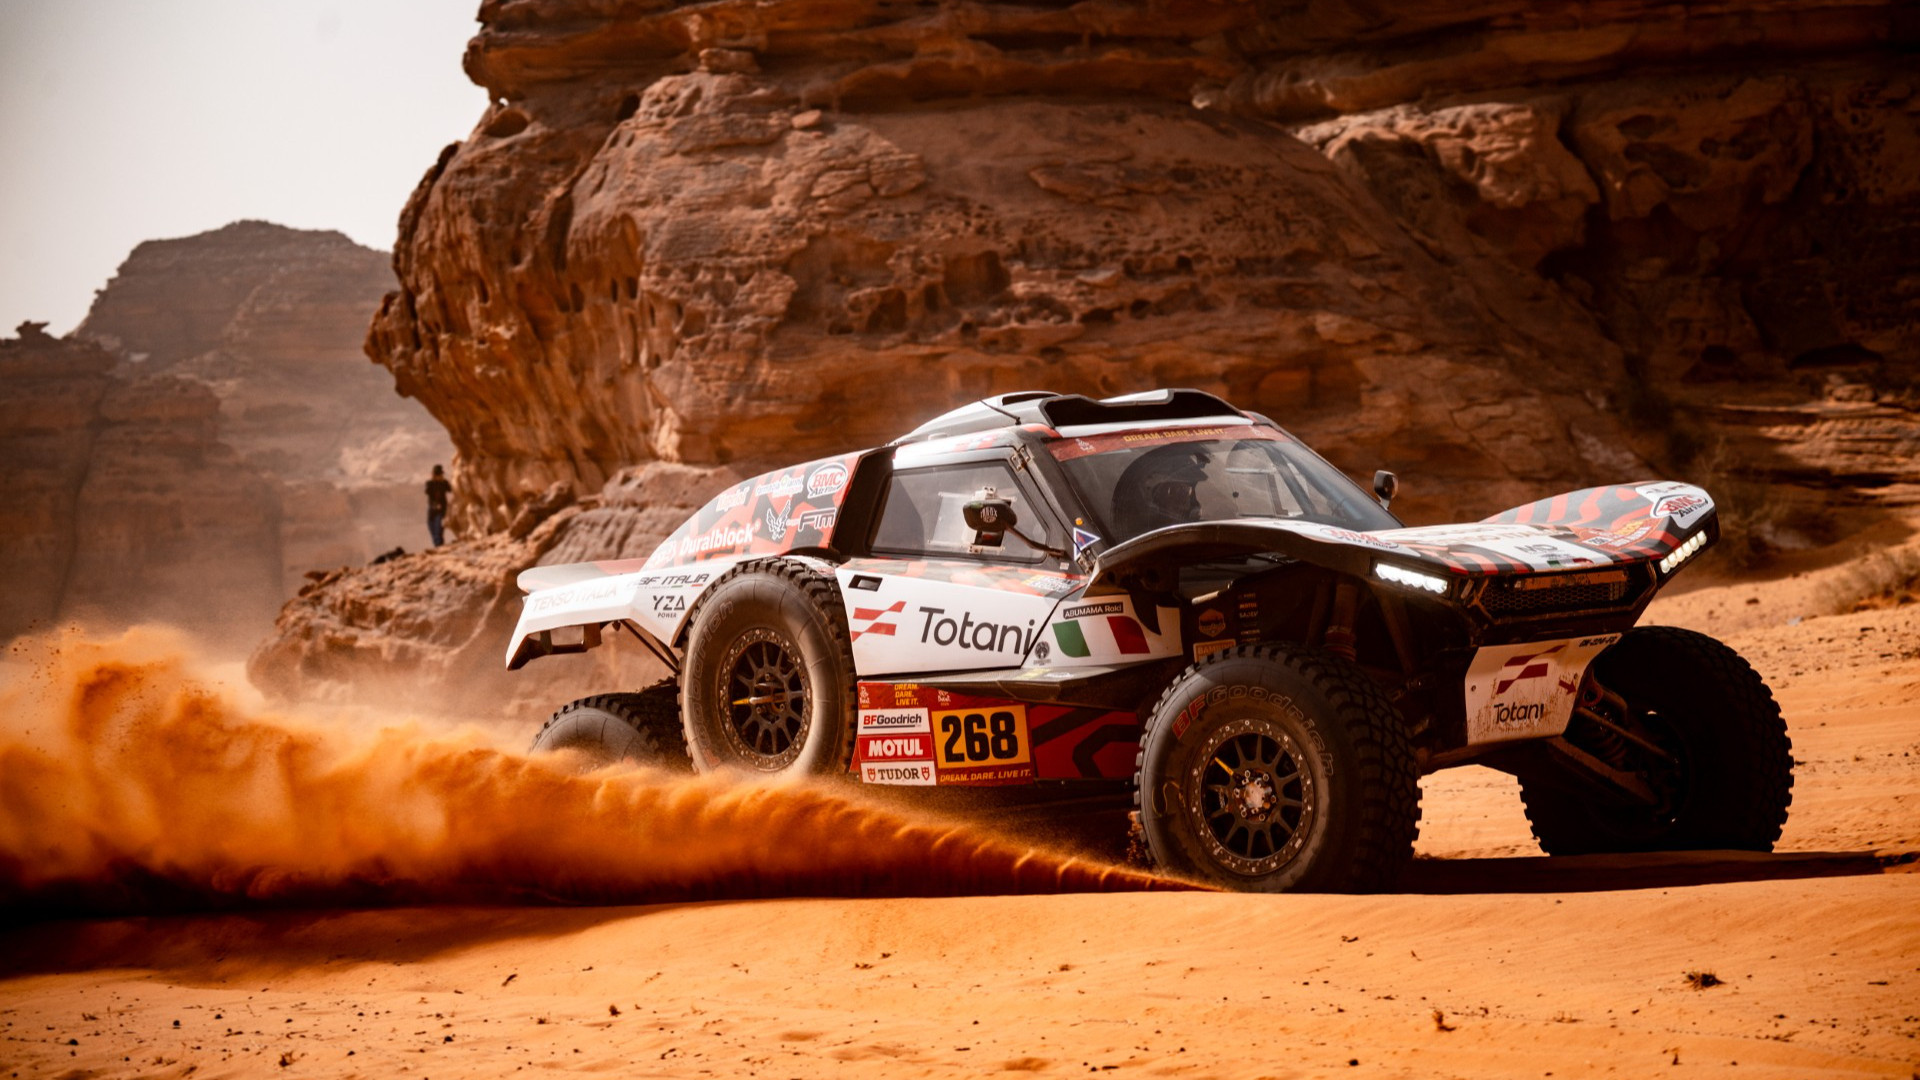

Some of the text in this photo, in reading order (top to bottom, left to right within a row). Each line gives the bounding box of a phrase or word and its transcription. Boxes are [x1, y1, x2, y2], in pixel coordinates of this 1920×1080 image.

[1123, 432, 1163, 442] DREAM.
[1165, 429, 1193, 439] DARE.
[812, 471, 843, 488] BMC
[679, 522, 753, 556] Duralblock
[662, 573, 710, 585] ITALIA
[1064, 606, 1103, 618] ABUMAMA
[919, 606, 1035, 655] Totani
[894, 683, 919, 691] DREAM.
[895, 690, 914, 698] DARE.
[863, 714, 922, 726] BFGoodrich
[1494, 703, 1544, 724] Totani
[941, 711, 1018, 763] 268
[1171, 685, 1333, 776] BFGoodrich
[868, 738, 923, 757] MOTUL
[878, 768, 920, 780] TUDOR
[940, 769, 1032, 782] DREAM. DARE. LIVE IT.
